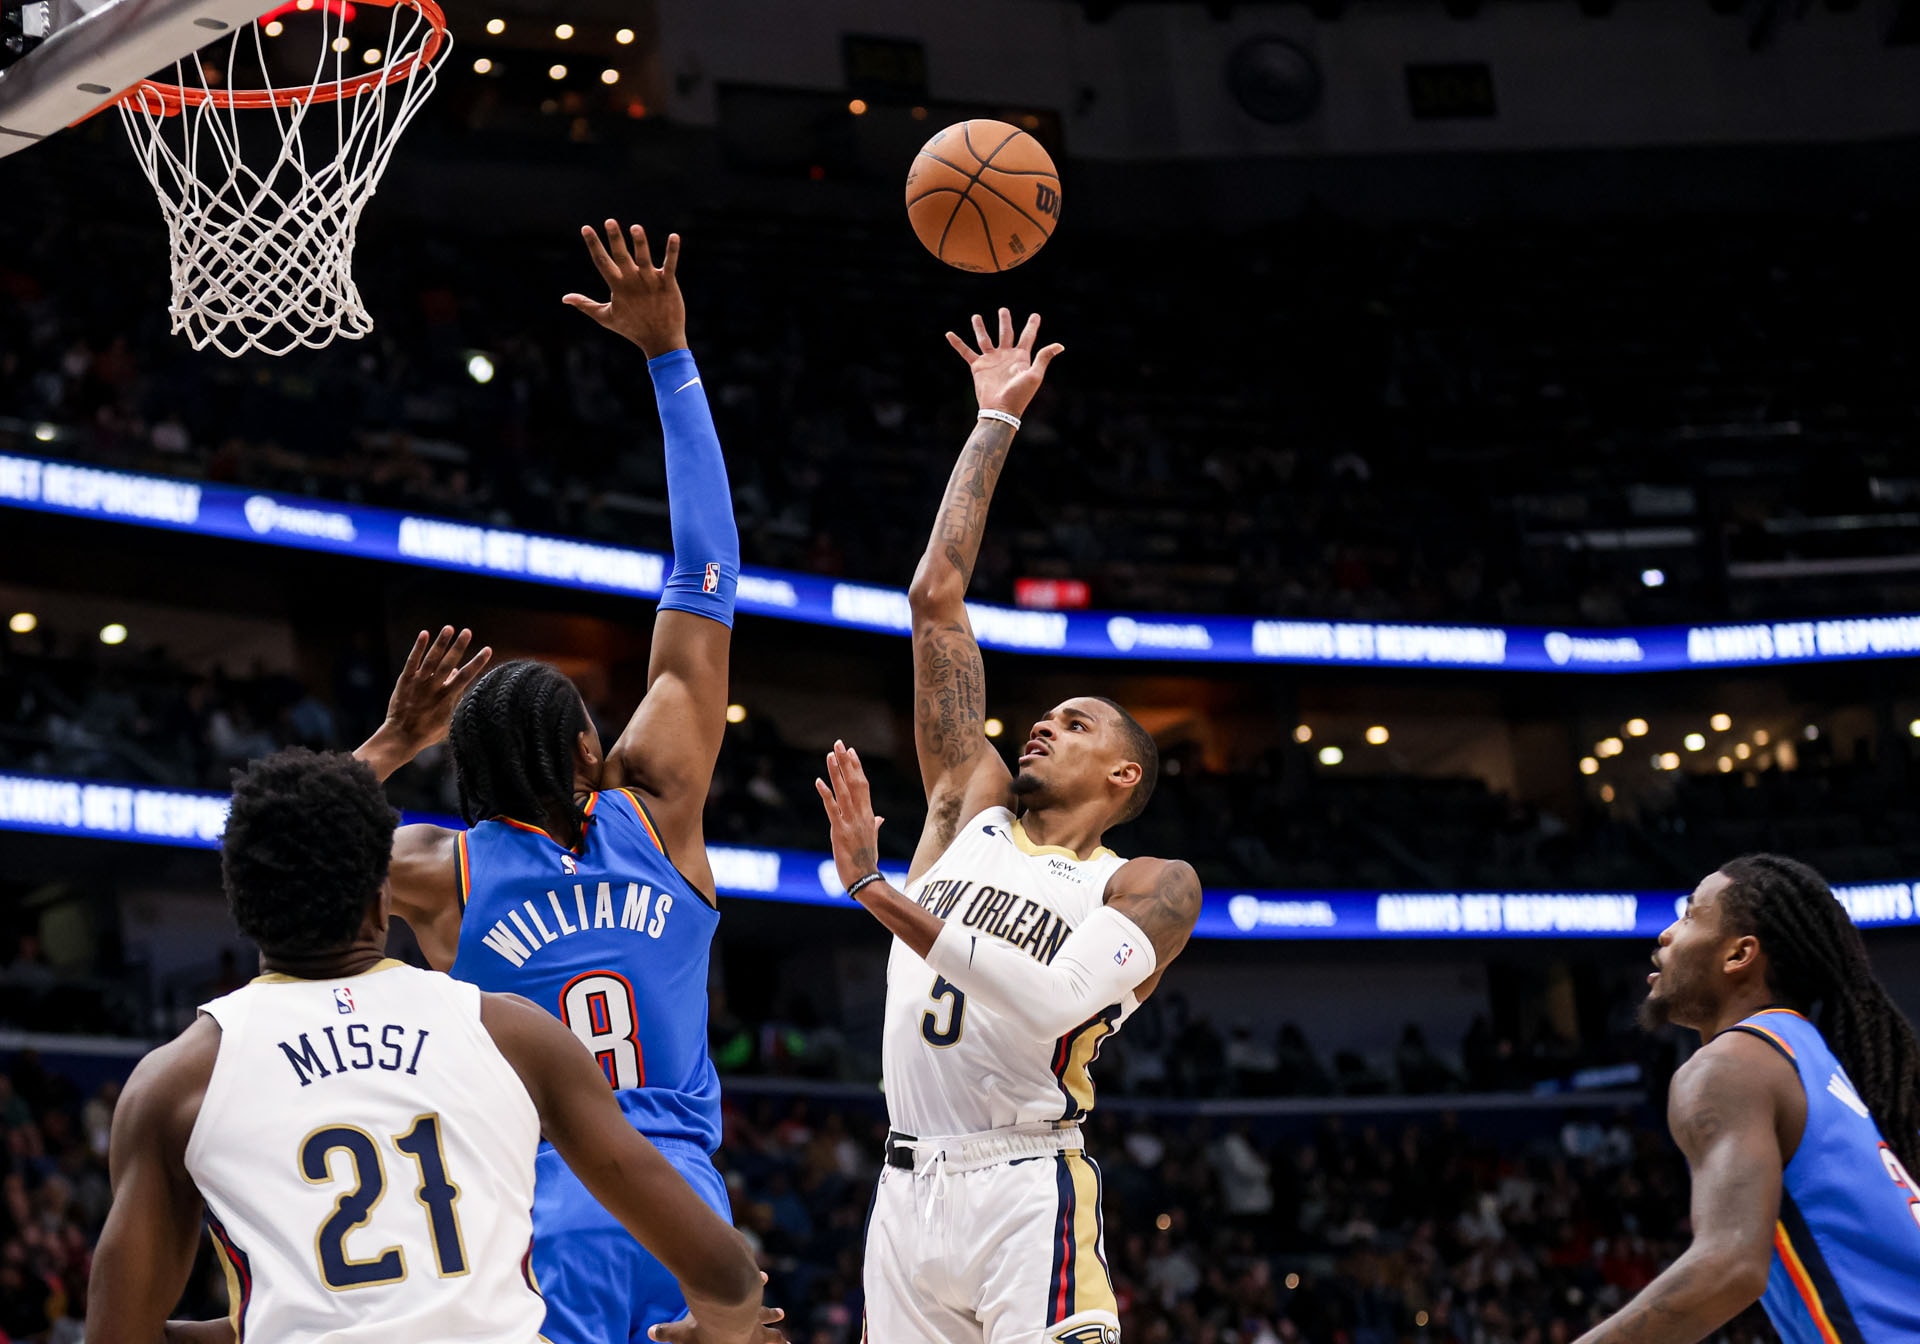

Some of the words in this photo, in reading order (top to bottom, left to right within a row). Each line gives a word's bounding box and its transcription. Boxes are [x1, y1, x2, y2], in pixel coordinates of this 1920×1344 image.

[481, 881, 673, 969] WILLIAMS
[917, 879, 973, 920] NEW
[962, 885, 1074, 967] ORLEAN
[278, 1023, 429, 1086] MISSI
[559, 969, 646, 1091] 8
[920, 973, 967, 1048] 5
[298, 1112, 470, 1292] 21
